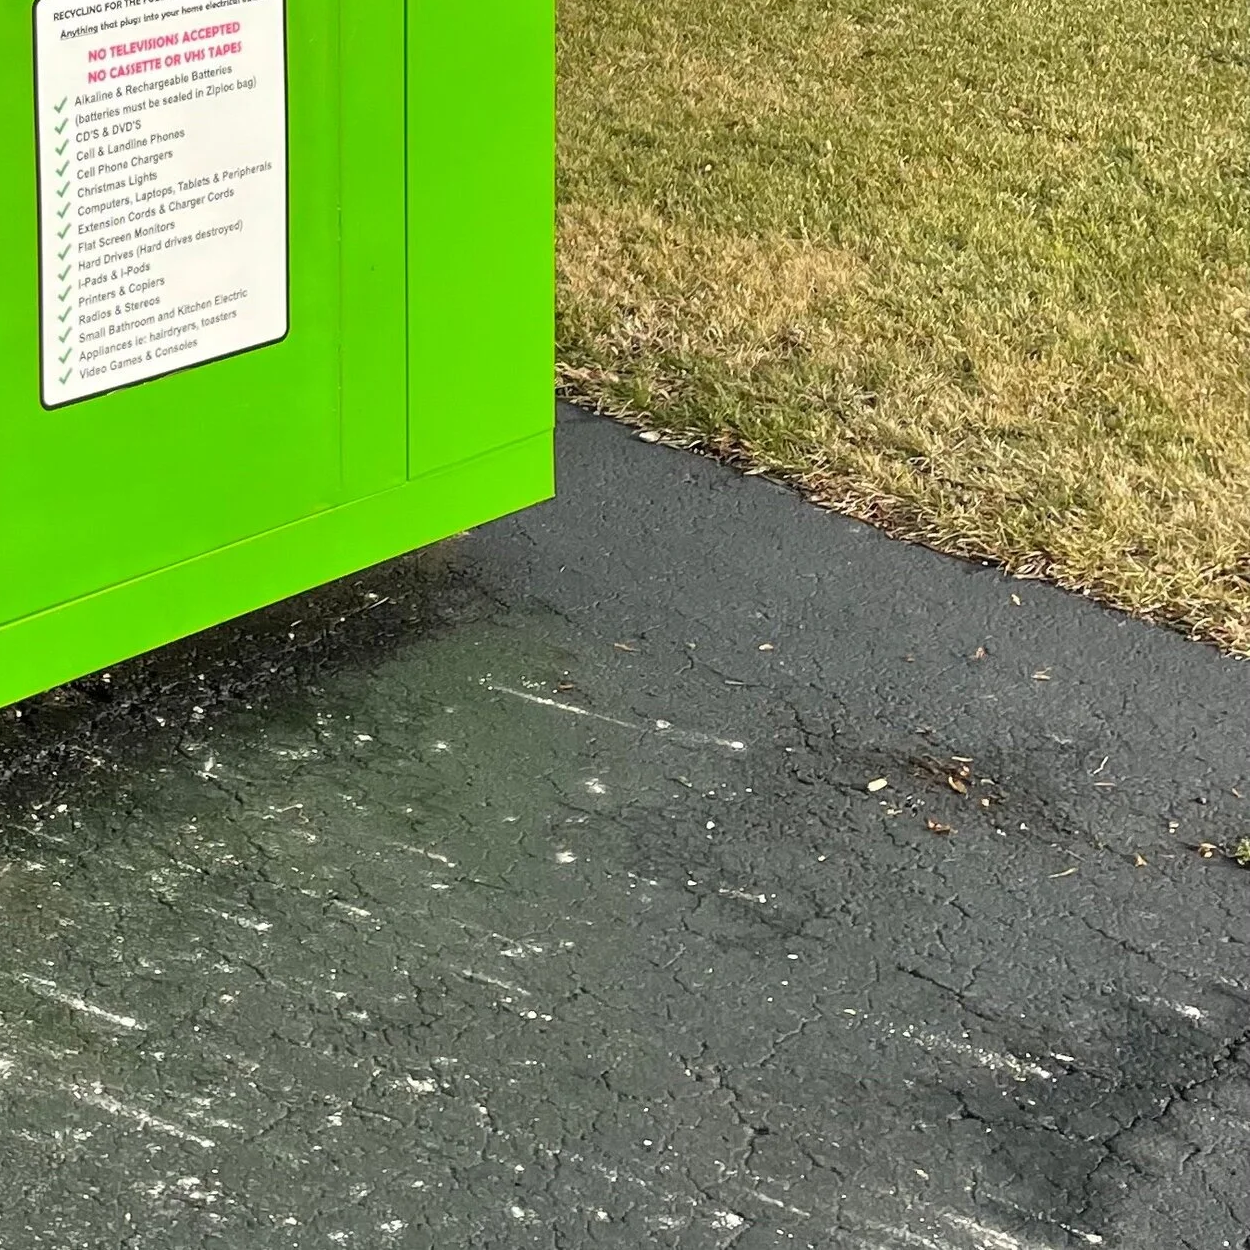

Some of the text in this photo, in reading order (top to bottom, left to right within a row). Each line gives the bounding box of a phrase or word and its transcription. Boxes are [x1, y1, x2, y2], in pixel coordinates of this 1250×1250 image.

[53, 1, 102, 21] RECYCLING
[105, 0, 122, 11] FOR
[60, 24, 98, 40] Anything
[100, 20, 118, 30] that
[120, 15, 141, 30] plugs
[144, 12, 159, 21] into
[161, 9, 179, 20] your
[181, 2, 203, 15] home
[88, 21, 240, 62] NO TELEVISIONS ACCEPTED
[88, 41, 242, 84] NO CASSETTE OR VHS TAPES
[74, 65, 232, 106] Alkaline & Rechargeable Batteries
[75, 107, 120, 127] (batteries
[123, 101, 147, 114] must
[149, 98, 160, 109] be
[162, 90, 193, 106] sealed
[196, 88, 204, 99] in
[237, 76, 257, 90] bag)
[76, 128, 185, 162] Cell & Landline Phones
[102, 128, 109, 137] &
[112, 119, 141, 135] DVD'S
[77, 149, 173, 180] Cell Phone Chargers
[178, 176, 210, 191] Tablets
[213, 172, 220, 183] &
[222, 160, 272, 180] Peripherals
[77, 171, 157, 198] Christmas Lights
[78, 188, 234, 235] Extension Cords & Charger Cords
[78, 220, 175, 253] Flat Screen Monitors
[78, 219, 243, 272] Hard Drives (Hard drives destroyed)
[79, 277, 165, 307] Printers & Copiers
[111, 270, 118, 280] &
[79, 296, 160, 326] Radios & Stereos
[79, 288, 248, 343] Small Bathroom and Kitchen Electric
[79, 340, 133, 362] Appliances
[201, 309, 237, 327] toasters
[80, 338, 198, 379] Video Games & Consoles
